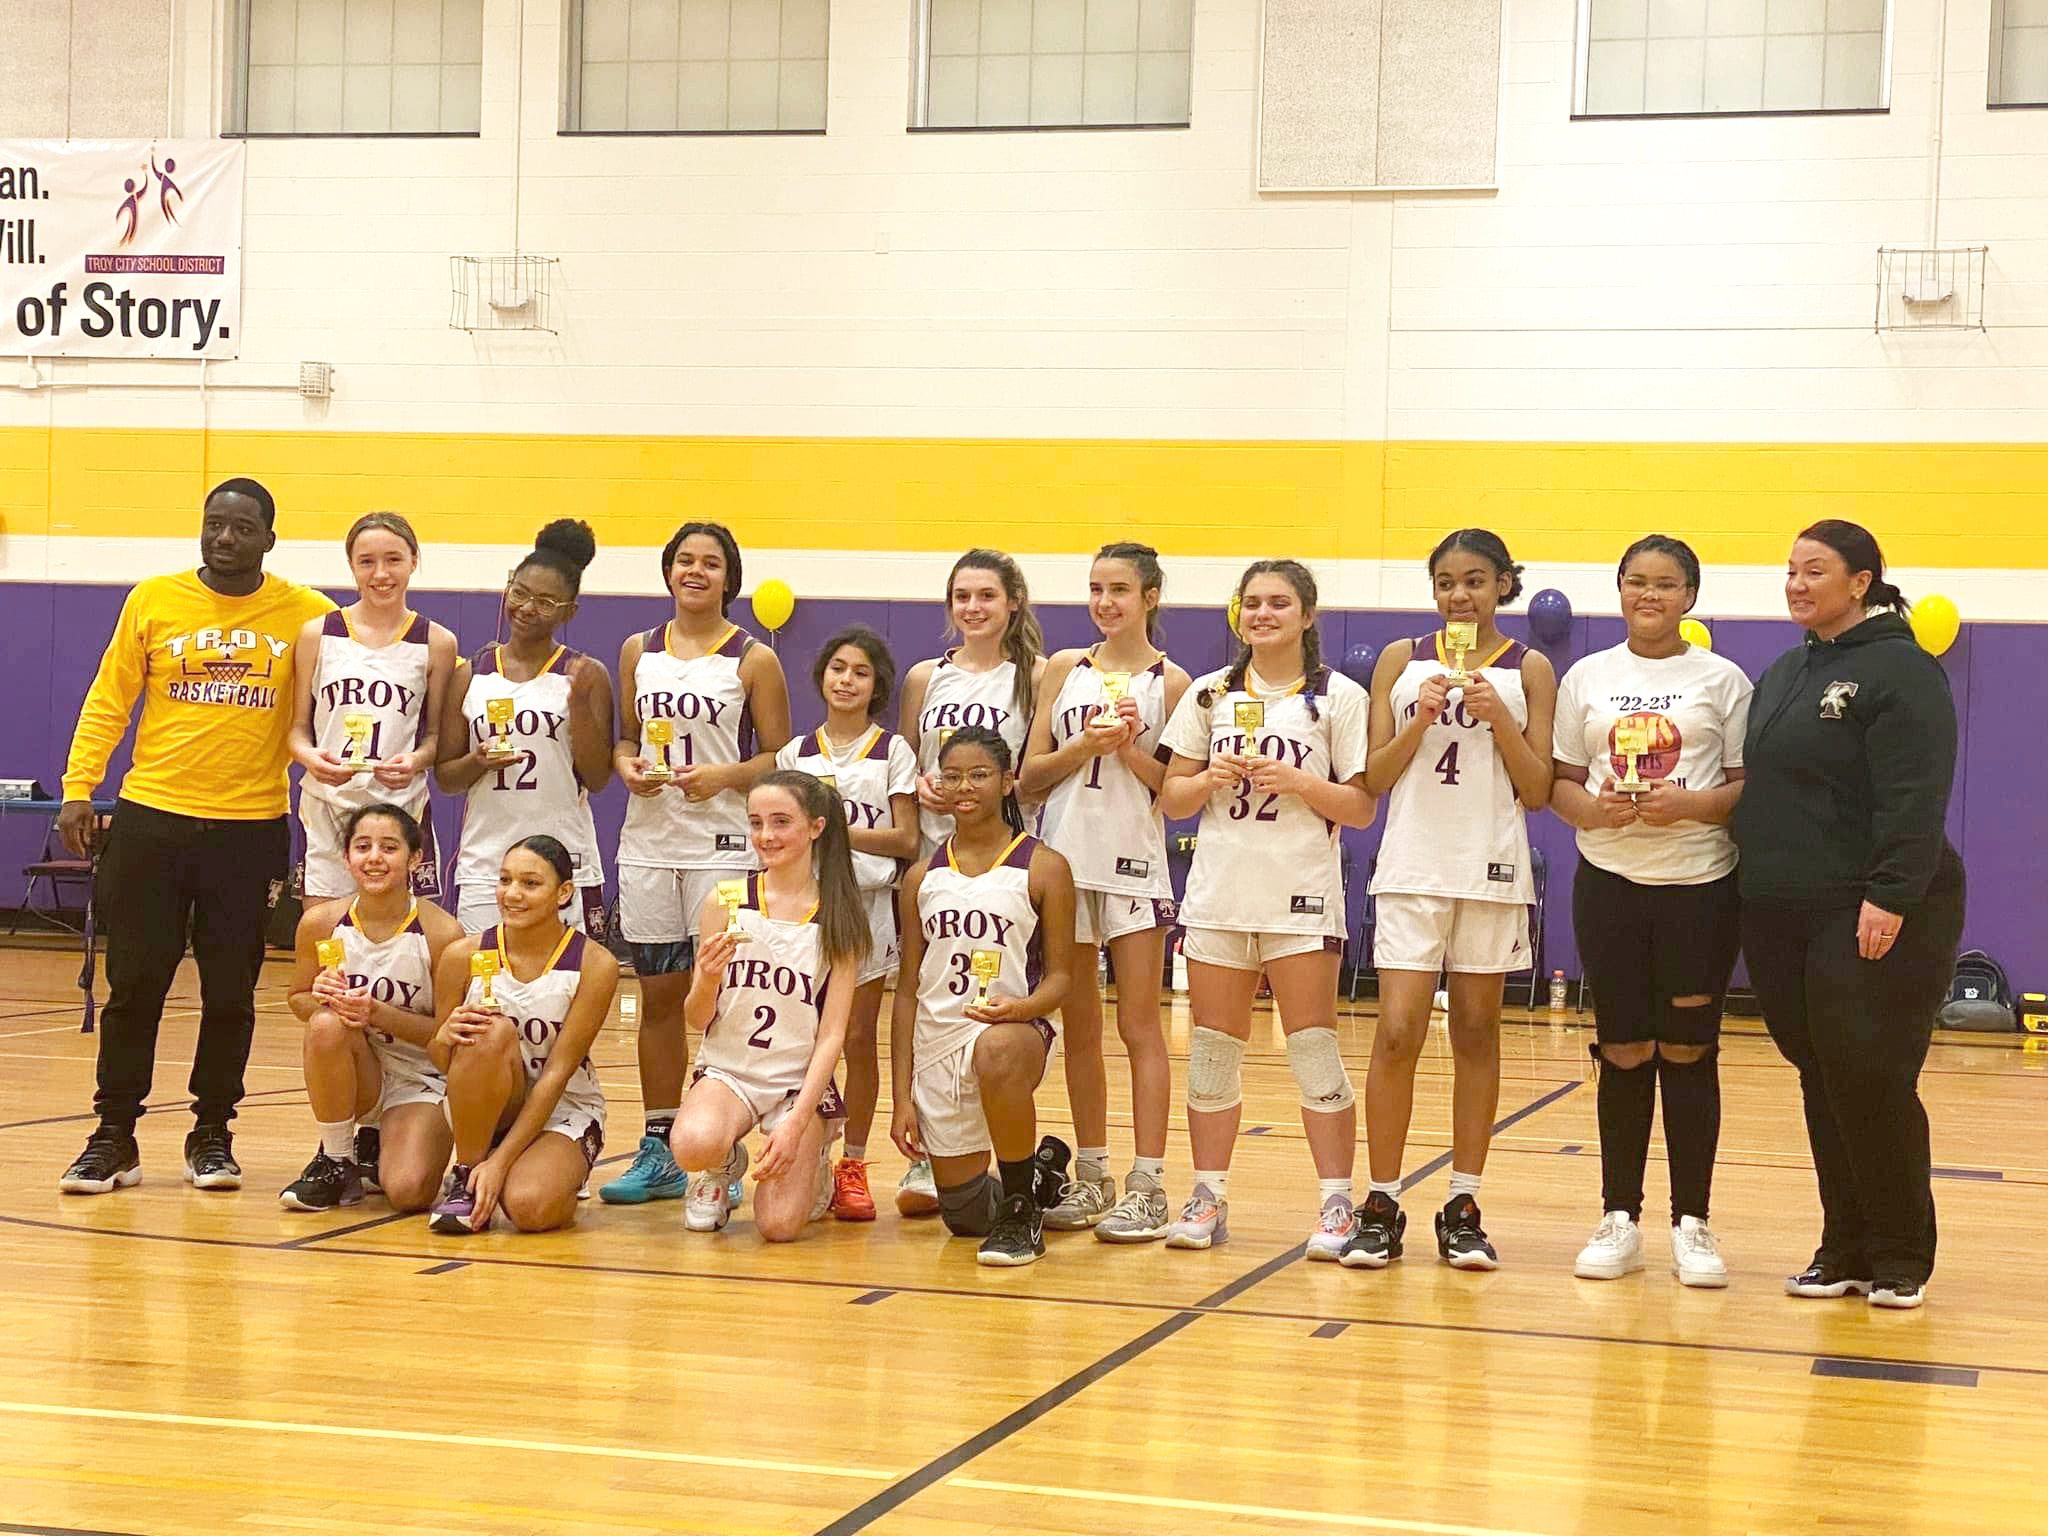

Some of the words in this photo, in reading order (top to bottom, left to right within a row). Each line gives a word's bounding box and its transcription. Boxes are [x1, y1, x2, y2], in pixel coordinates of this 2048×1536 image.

[0, 218, 45, 264] ill.
[88, 257, 113, 271] TROY
[115, 257, 137, 271] CITY
[137, 257, 176, 272] SCHOOL
[178, 258, 222, 272] DISTRICT
[17, 282, 67, 336] of
[80, 282, 230, 350] Story.
[165, 628, 289, 658] TROY
[169, 681, 277, 709] BASKETBALL
[321, 677, 416, 716] TROY
[637, 691, 727, 728] TROY
[922, 702, 1010, 737] TROY
[1434, 741, 1461, 786] 4
[925, 909, 1014, 947] TROY
[726, 960, 814, 1006] TROY
[747, 1005, 776, 1049] 2
